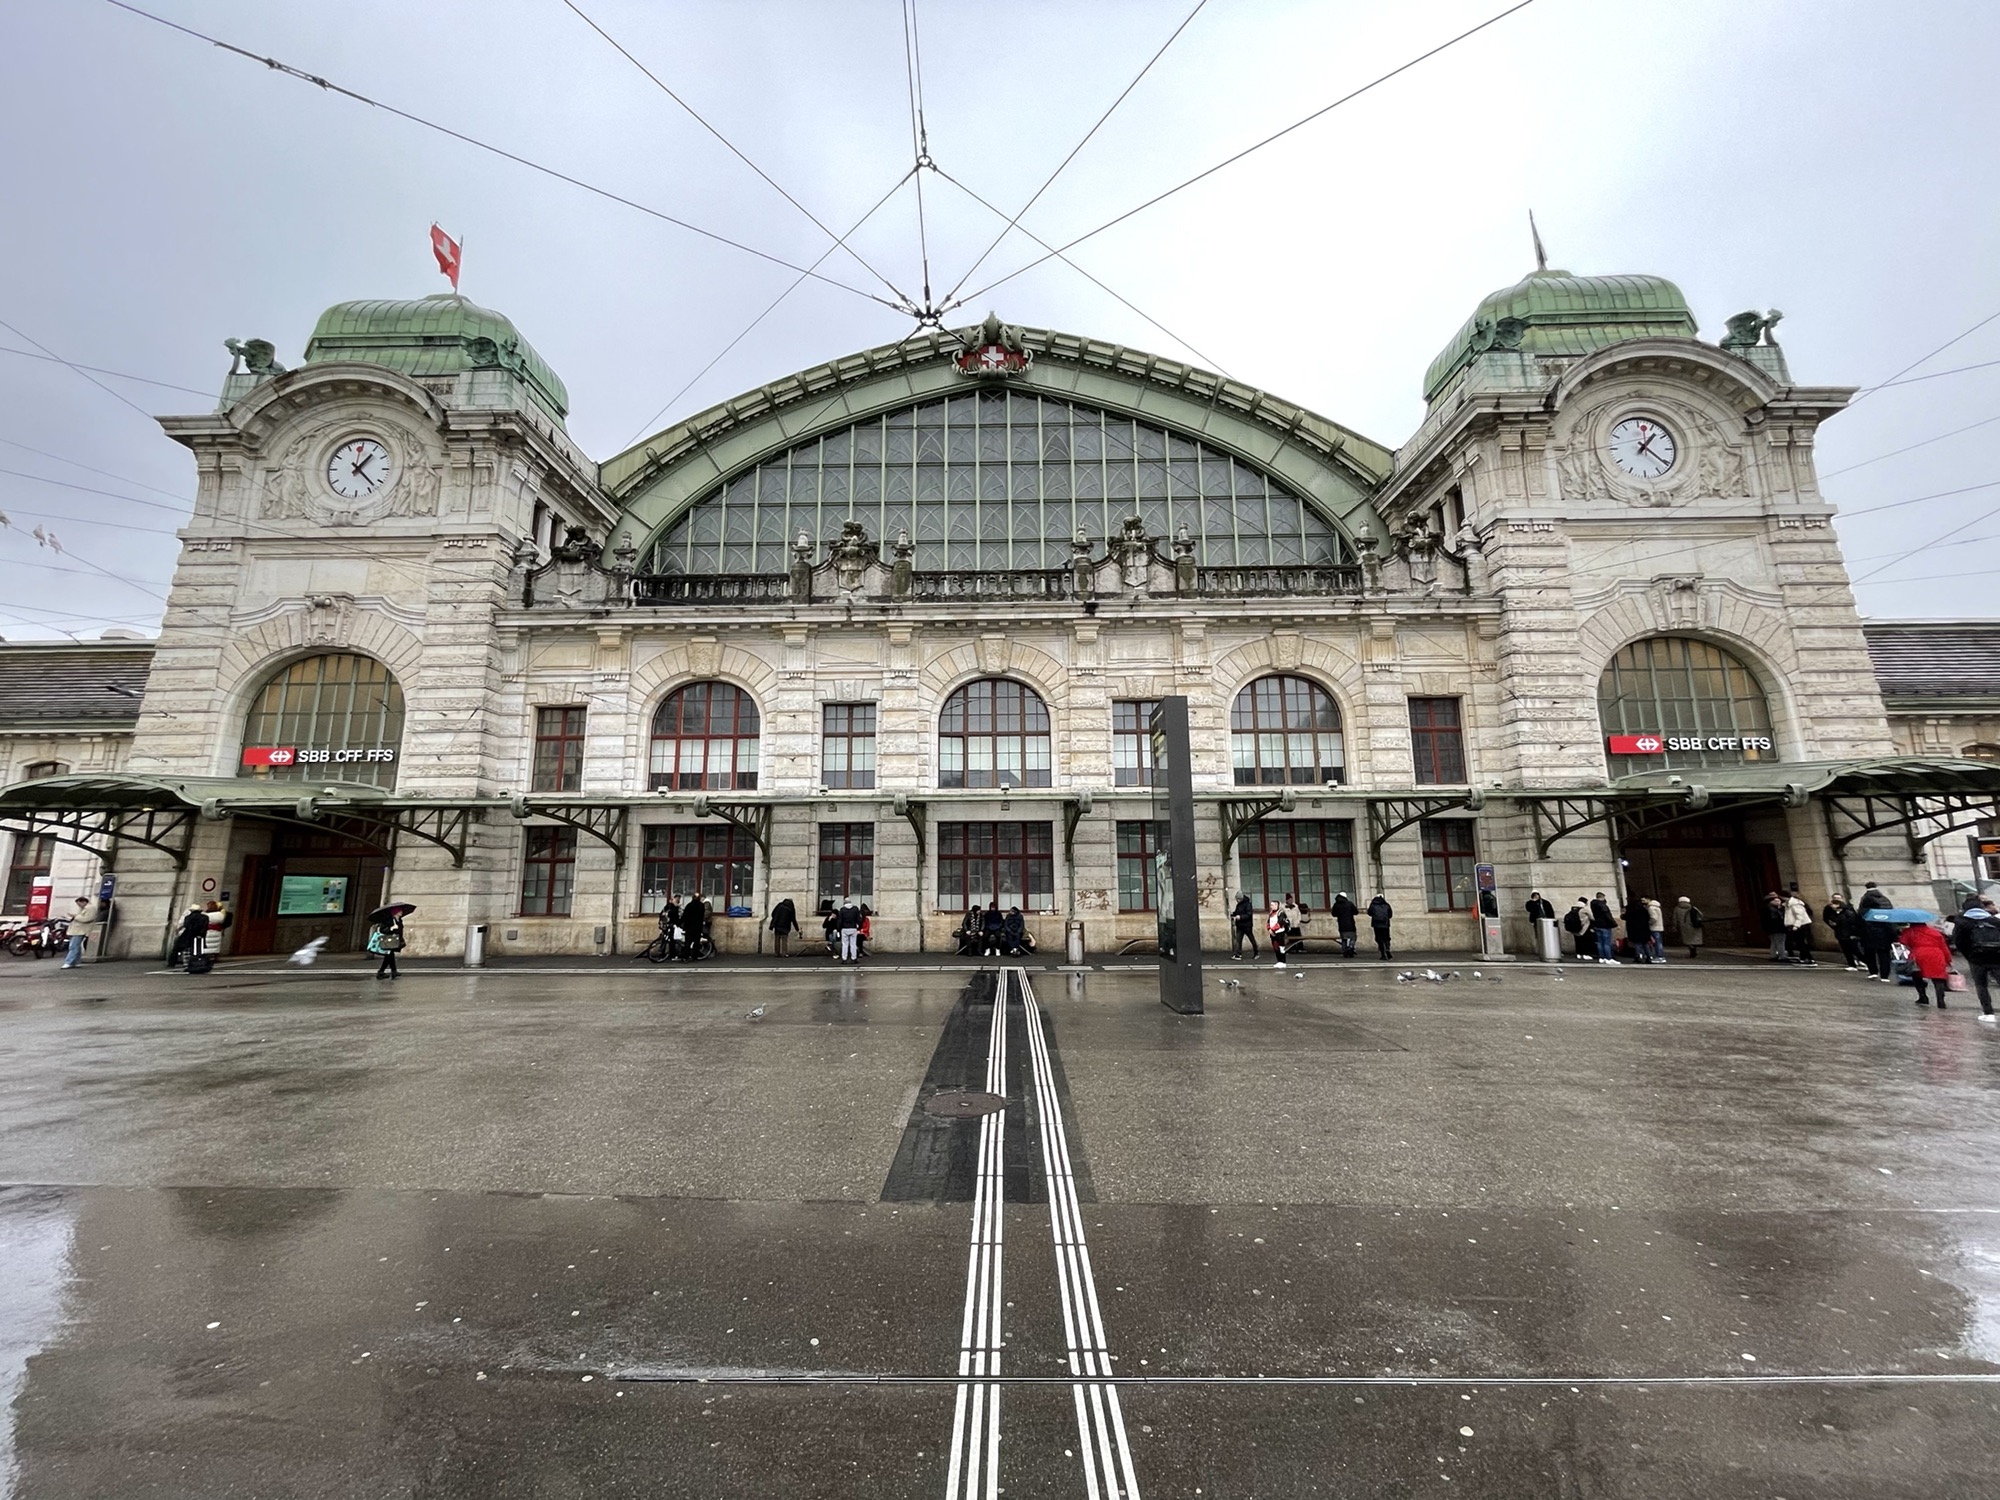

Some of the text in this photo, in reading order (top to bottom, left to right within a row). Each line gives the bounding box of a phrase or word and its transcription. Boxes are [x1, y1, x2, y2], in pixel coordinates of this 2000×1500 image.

[1668, 737, 1771, 750] SBB CFF FFS
[298, 749, 393, 762] SBB CFF FFS
